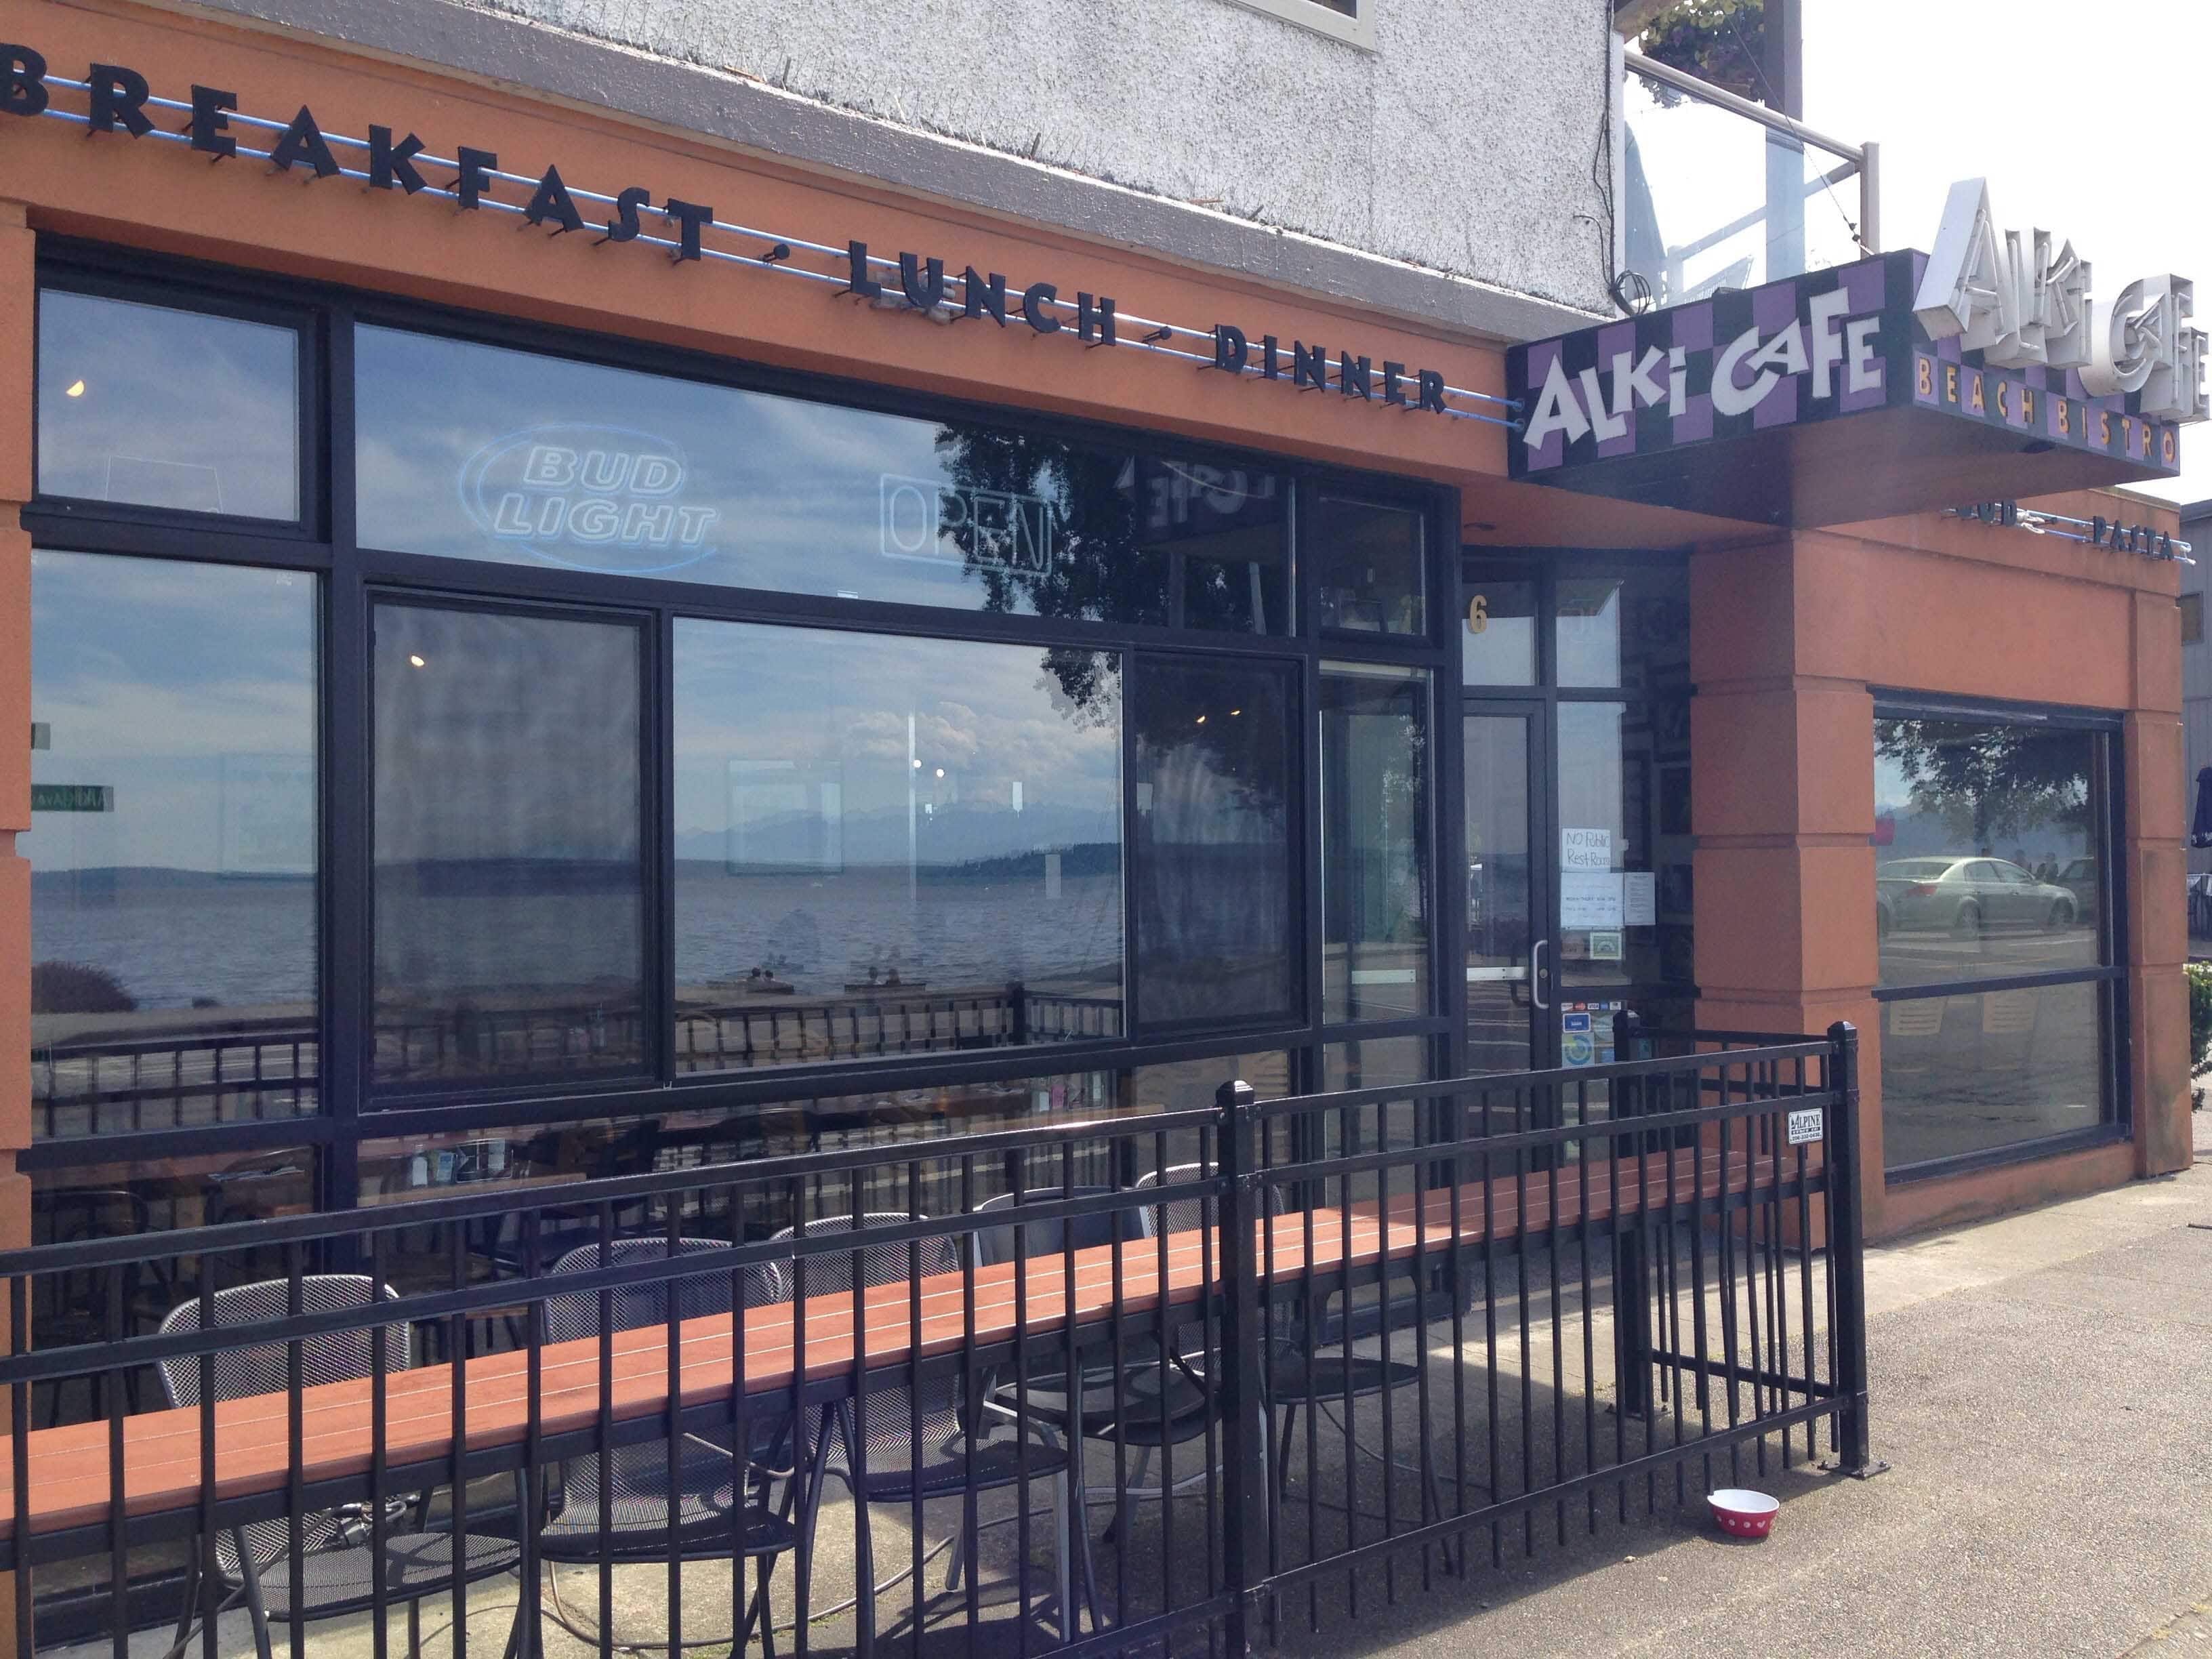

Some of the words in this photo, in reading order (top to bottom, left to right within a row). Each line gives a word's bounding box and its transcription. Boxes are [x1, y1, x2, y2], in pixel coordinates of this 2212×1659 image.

[0, 43, 714, 262] BREAKFAST
[850, 240, 1116, 346] LUNCH
[1215, 324, 1447, 415] DINNER
[1711, 287, 1882, 417] CAFE
[1918, 357, 2034, 424] BEACH
[2057, 400, 2175, 463] BISTRO
[523, 445, 686, 497] BUD
[494, 493, 718, 547] LIGHT
[889, 485, 1044, 571] OPEN
[2093, 515, 2175, 561] PASTA
[1469, 594, 1488, 634] 6
[1793, 1113, 1821, 1129] ALPINE
